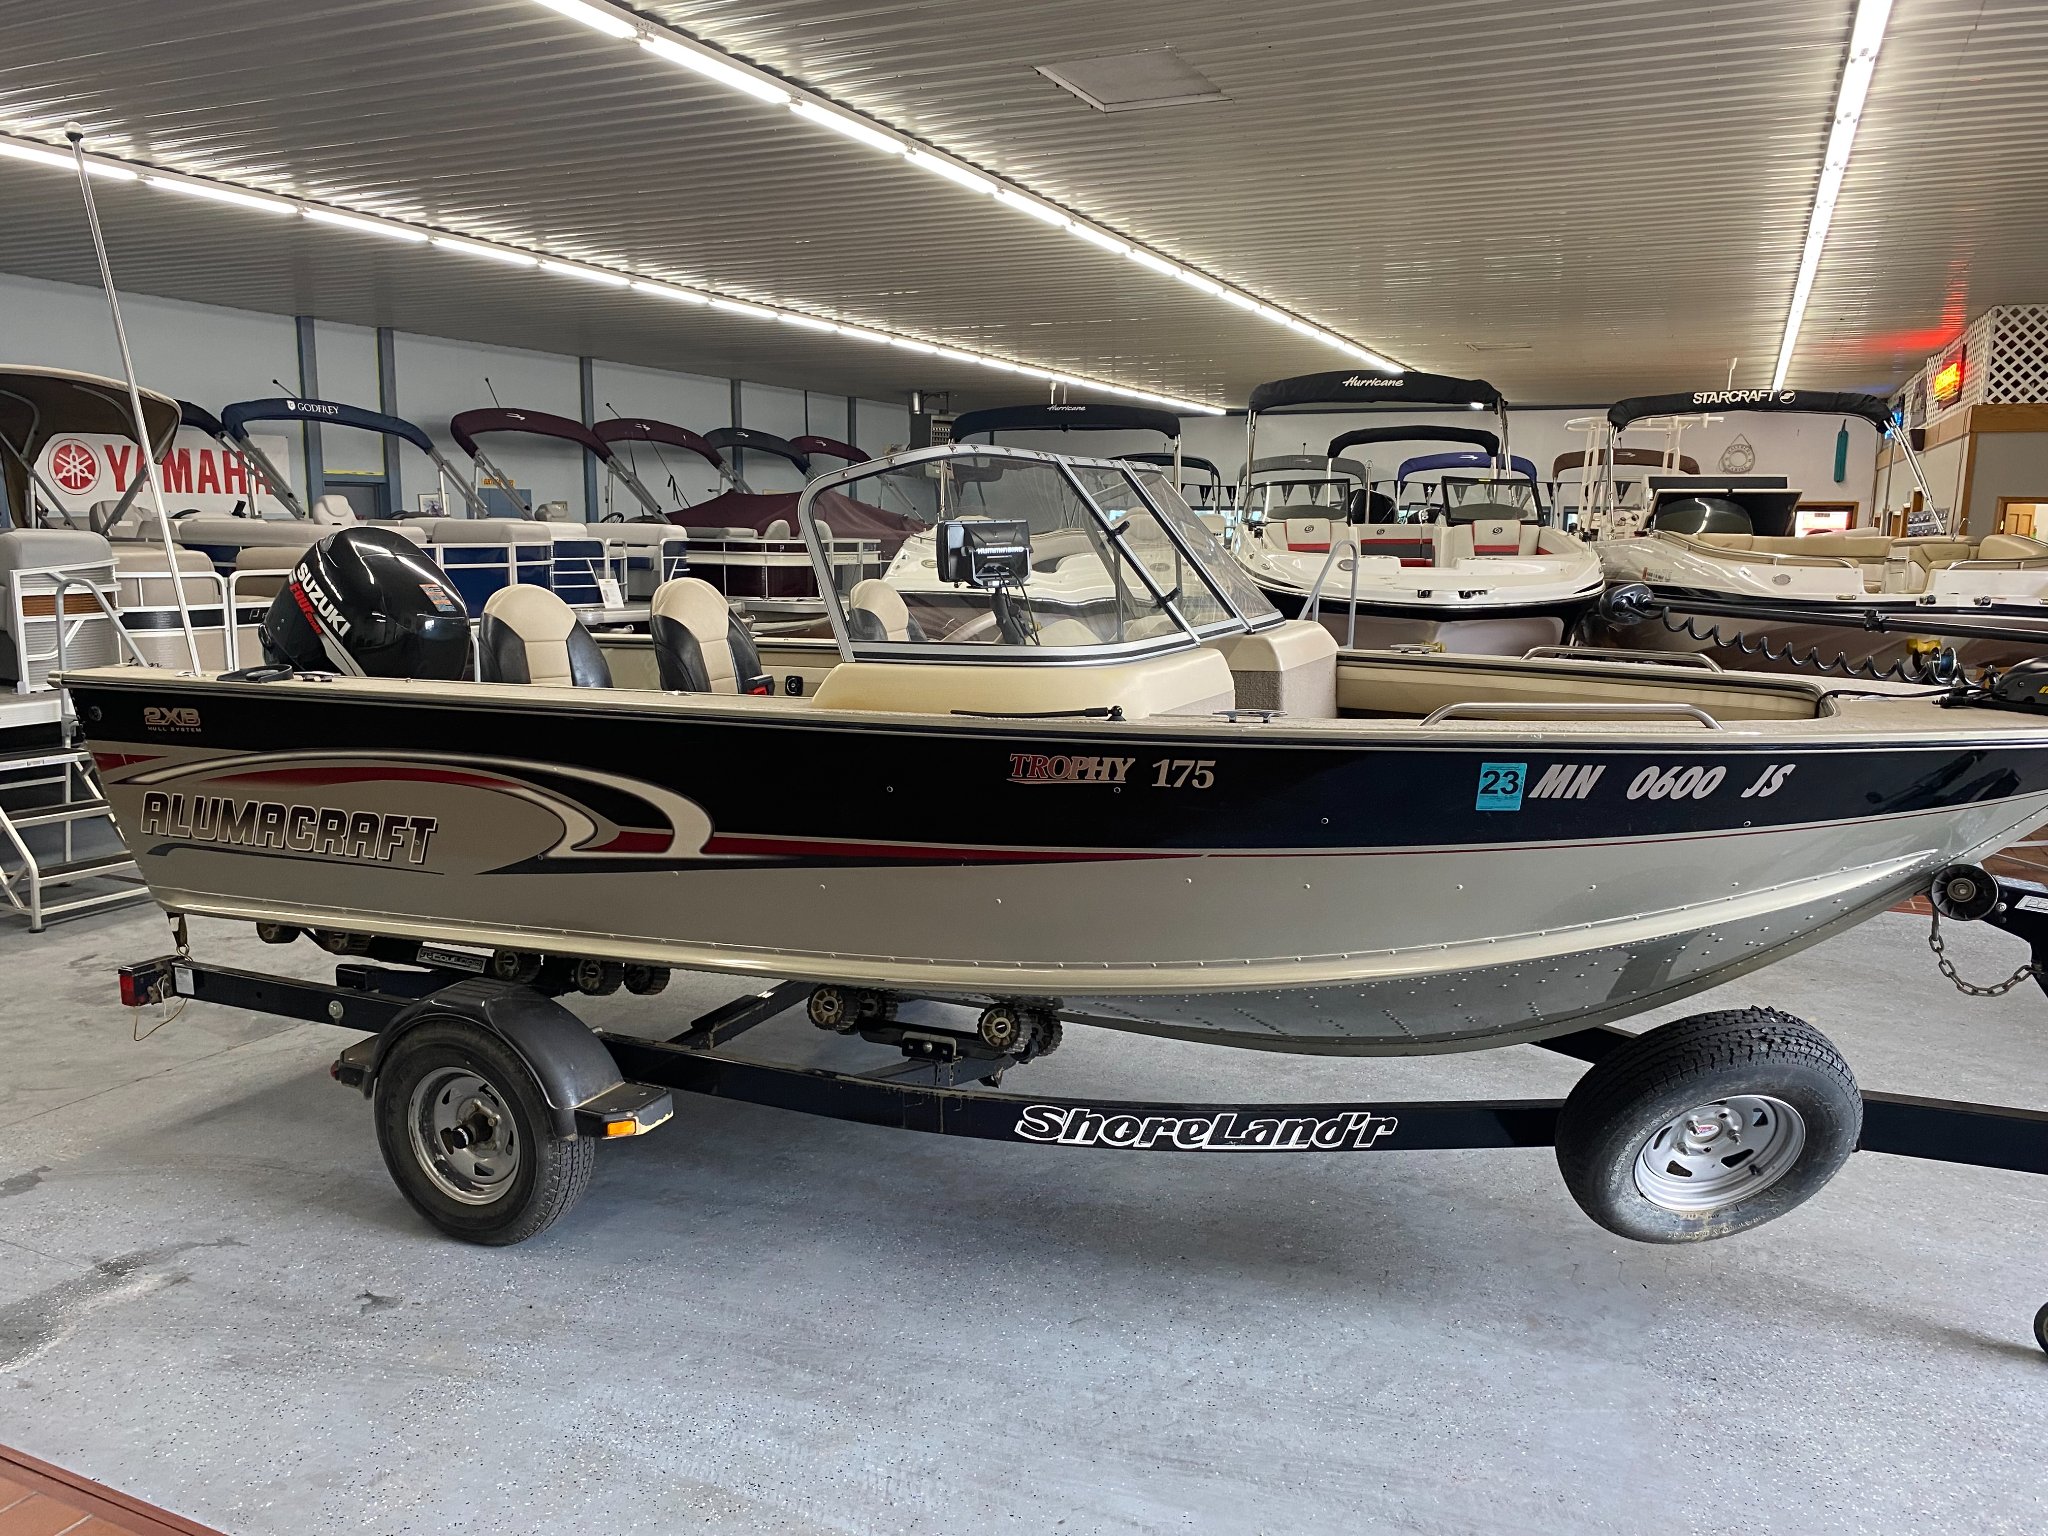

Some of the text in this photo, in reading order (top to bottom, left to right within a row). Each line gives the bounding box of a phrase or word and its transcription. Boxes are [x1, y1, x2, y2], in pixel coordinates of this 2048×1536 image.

[1342, 375, 1404, 387] Hurricane
[1692, 390, 1777, 404] STARCRAFT
[297, 402, 339, 415] GODFREY
[296, 562, 352, 637] SUZUKI
[1009, 753, 1216, 789] TROPHY 175
[1480, 770, 1519, 795] 23
[1528, 764, 1796, 800] MN 0600 JS
[141, 791, 438, 865] ALUMACRAFT
[1014, 1104, 1398, 1150] ShoreLand'r
